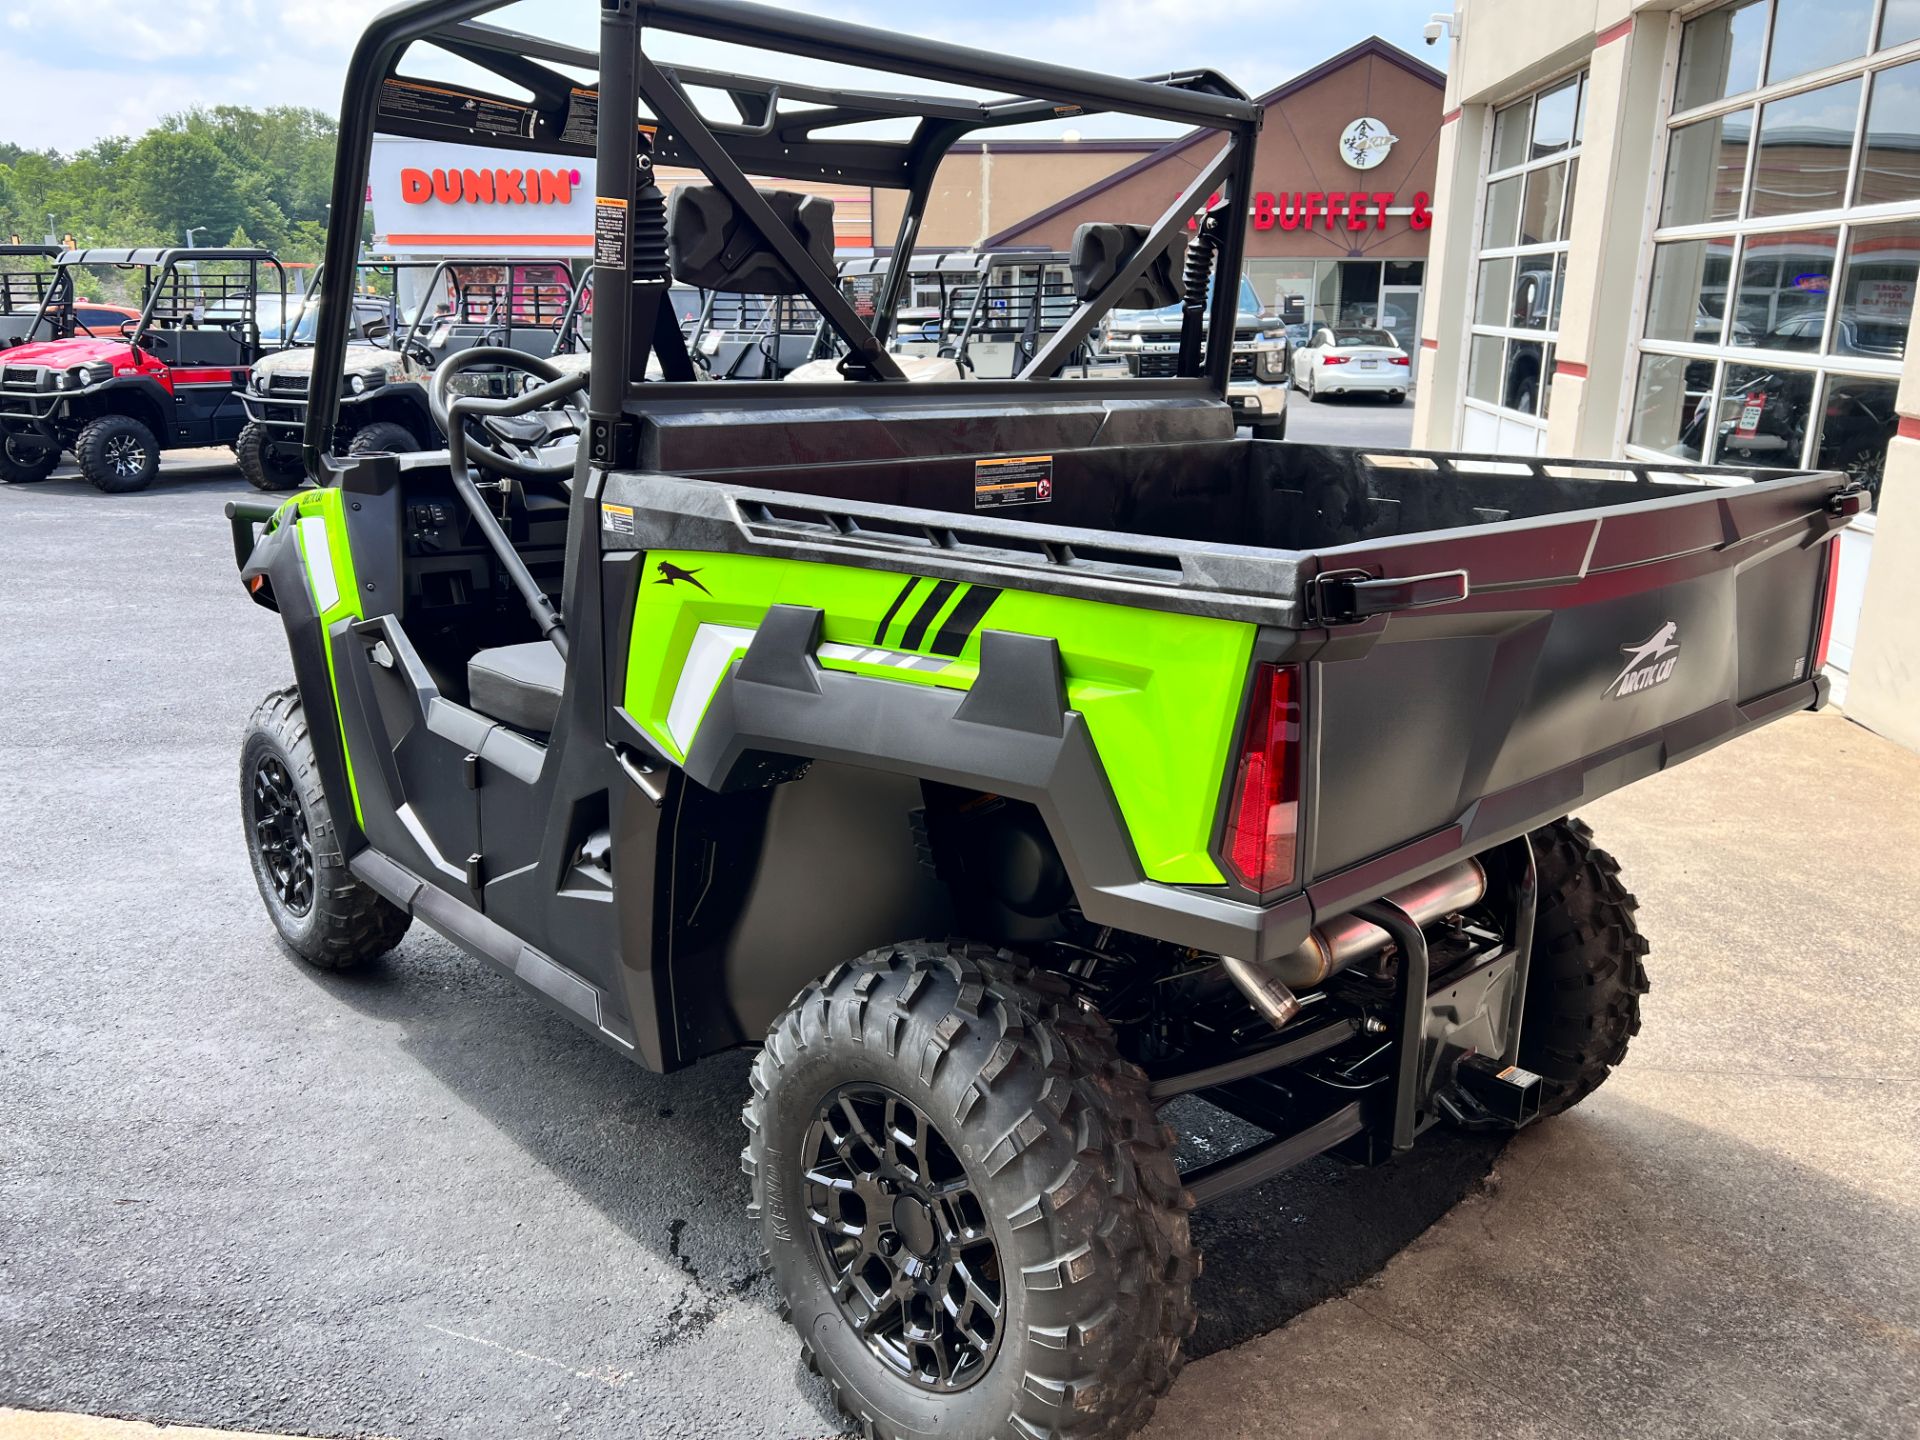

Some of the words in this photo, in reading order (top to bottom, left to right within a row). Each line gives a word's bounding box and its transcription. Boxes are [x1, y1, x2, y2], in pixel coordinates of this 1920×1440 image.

[401, 168, 581, 205] DUNKIN'
[1254, 191, 1395, 231] BUFFET
[1410, 191, 1433, 231] &
[1616, 663, 1659, 697] ARCTIC
[1656, 656, 1678, 683] CAT
